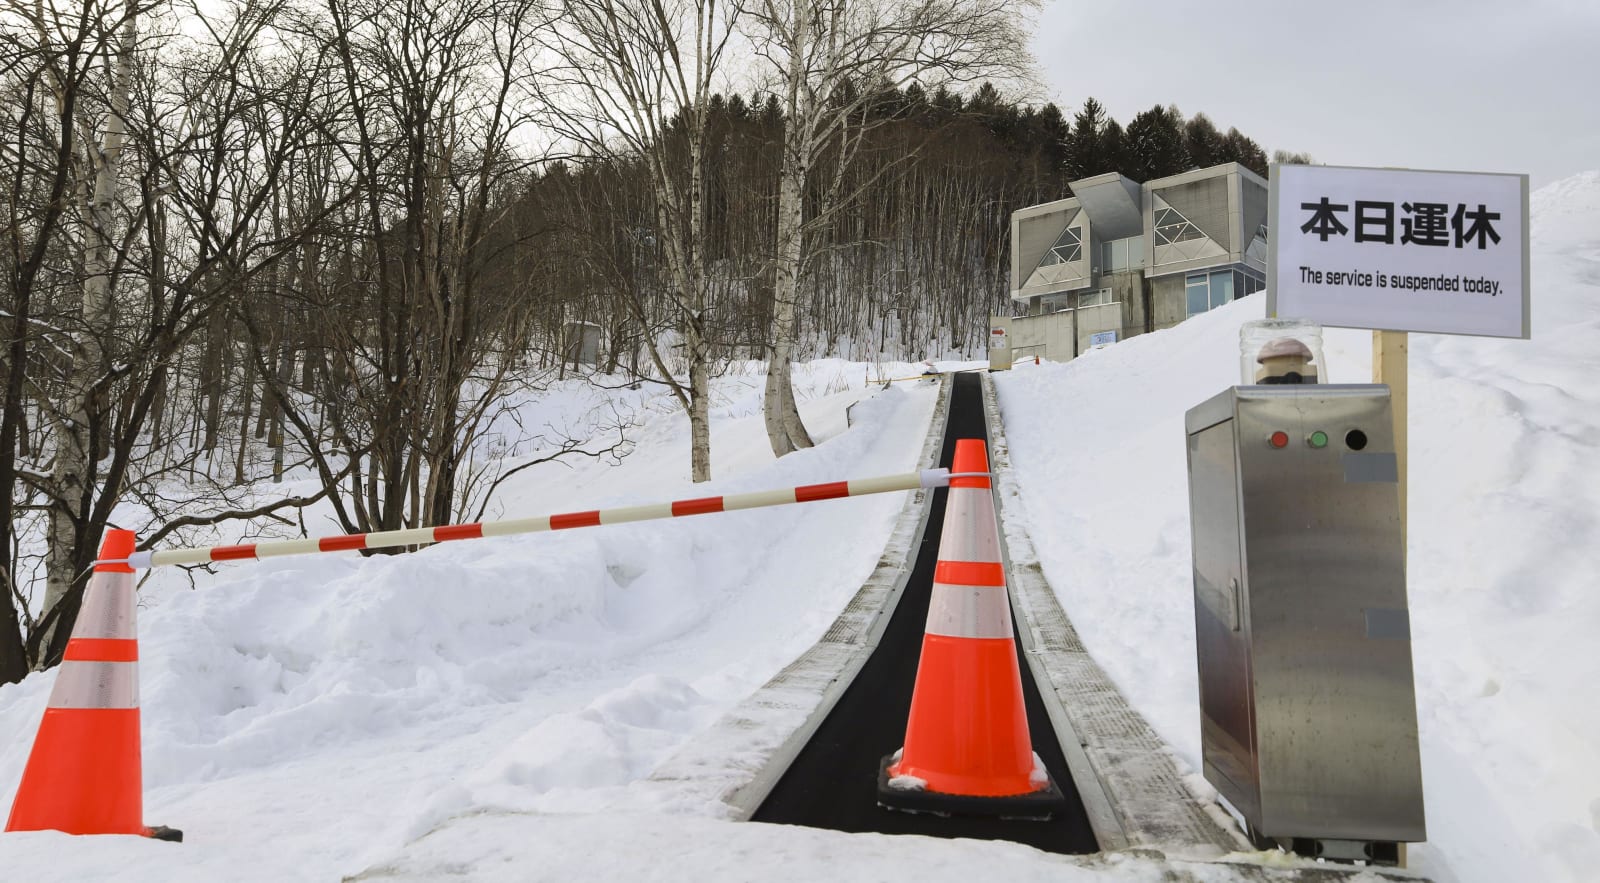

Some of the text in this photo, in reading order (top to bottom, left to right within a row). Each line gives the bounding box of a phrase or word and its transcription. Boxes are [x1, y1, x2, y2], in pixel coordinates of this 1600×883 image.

[1300, 197, 1502, 250] 本日運休
[1299, 266, 1503, 297] The service is suspended today.
